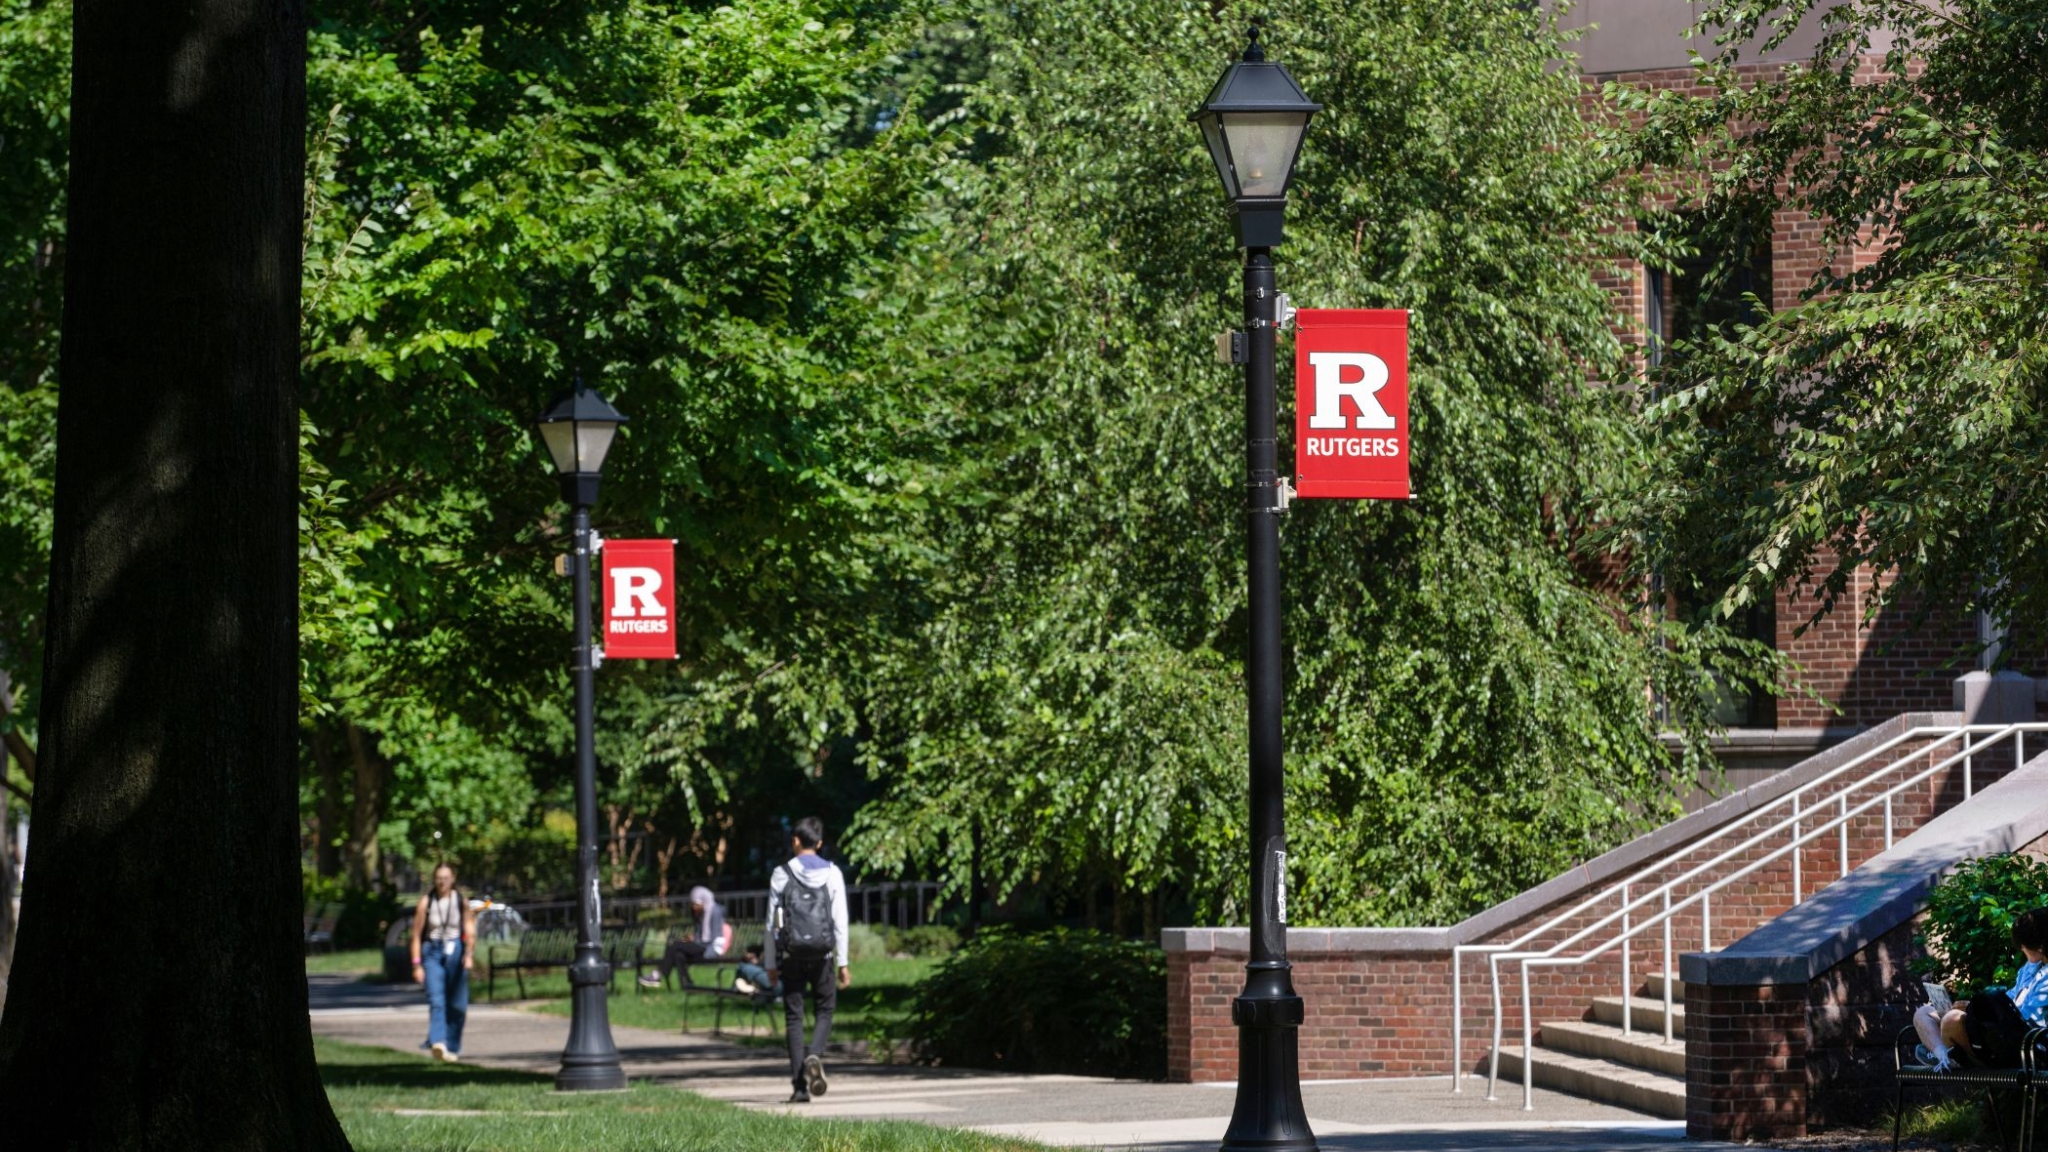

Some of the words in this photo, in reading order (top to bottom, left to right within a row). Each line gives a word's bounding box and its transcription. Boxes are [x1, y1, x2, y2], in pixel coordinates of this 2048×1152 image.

[1309, 352, 1396, 430] R
[1306, 437, 1400, 457] RUTGERS
[610, 567, 667, 617] R
[610, 620, 668, 633] RUTGERS
